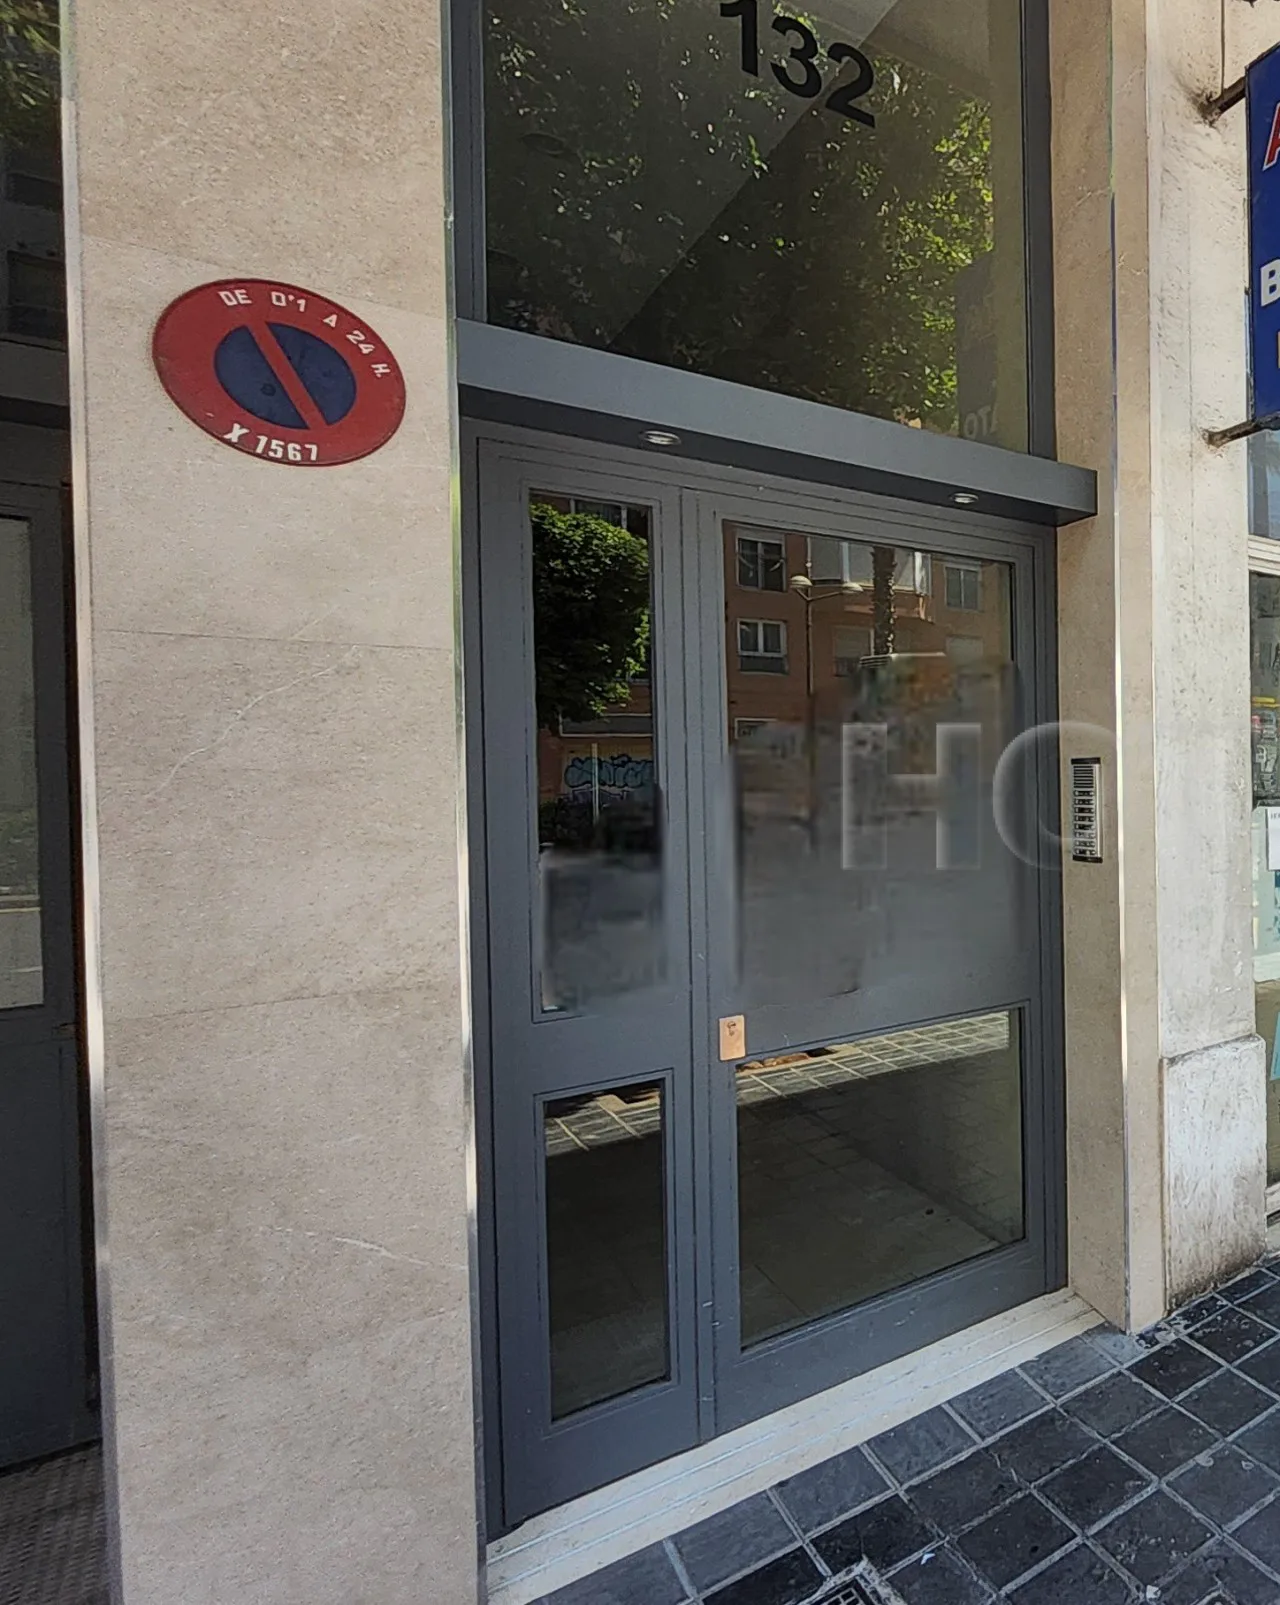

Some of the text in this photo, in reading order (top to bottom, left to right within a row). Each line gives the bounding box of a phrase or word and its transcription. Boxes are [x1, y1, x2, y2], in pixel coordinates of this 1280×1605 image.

[720, 0, 875, 129] 132
[218, 289, 252, 306] DE
[323, 314, 338, 327] A
[346, 330, 376, 354] 24
[224, 423, 318, 461] X 1567
